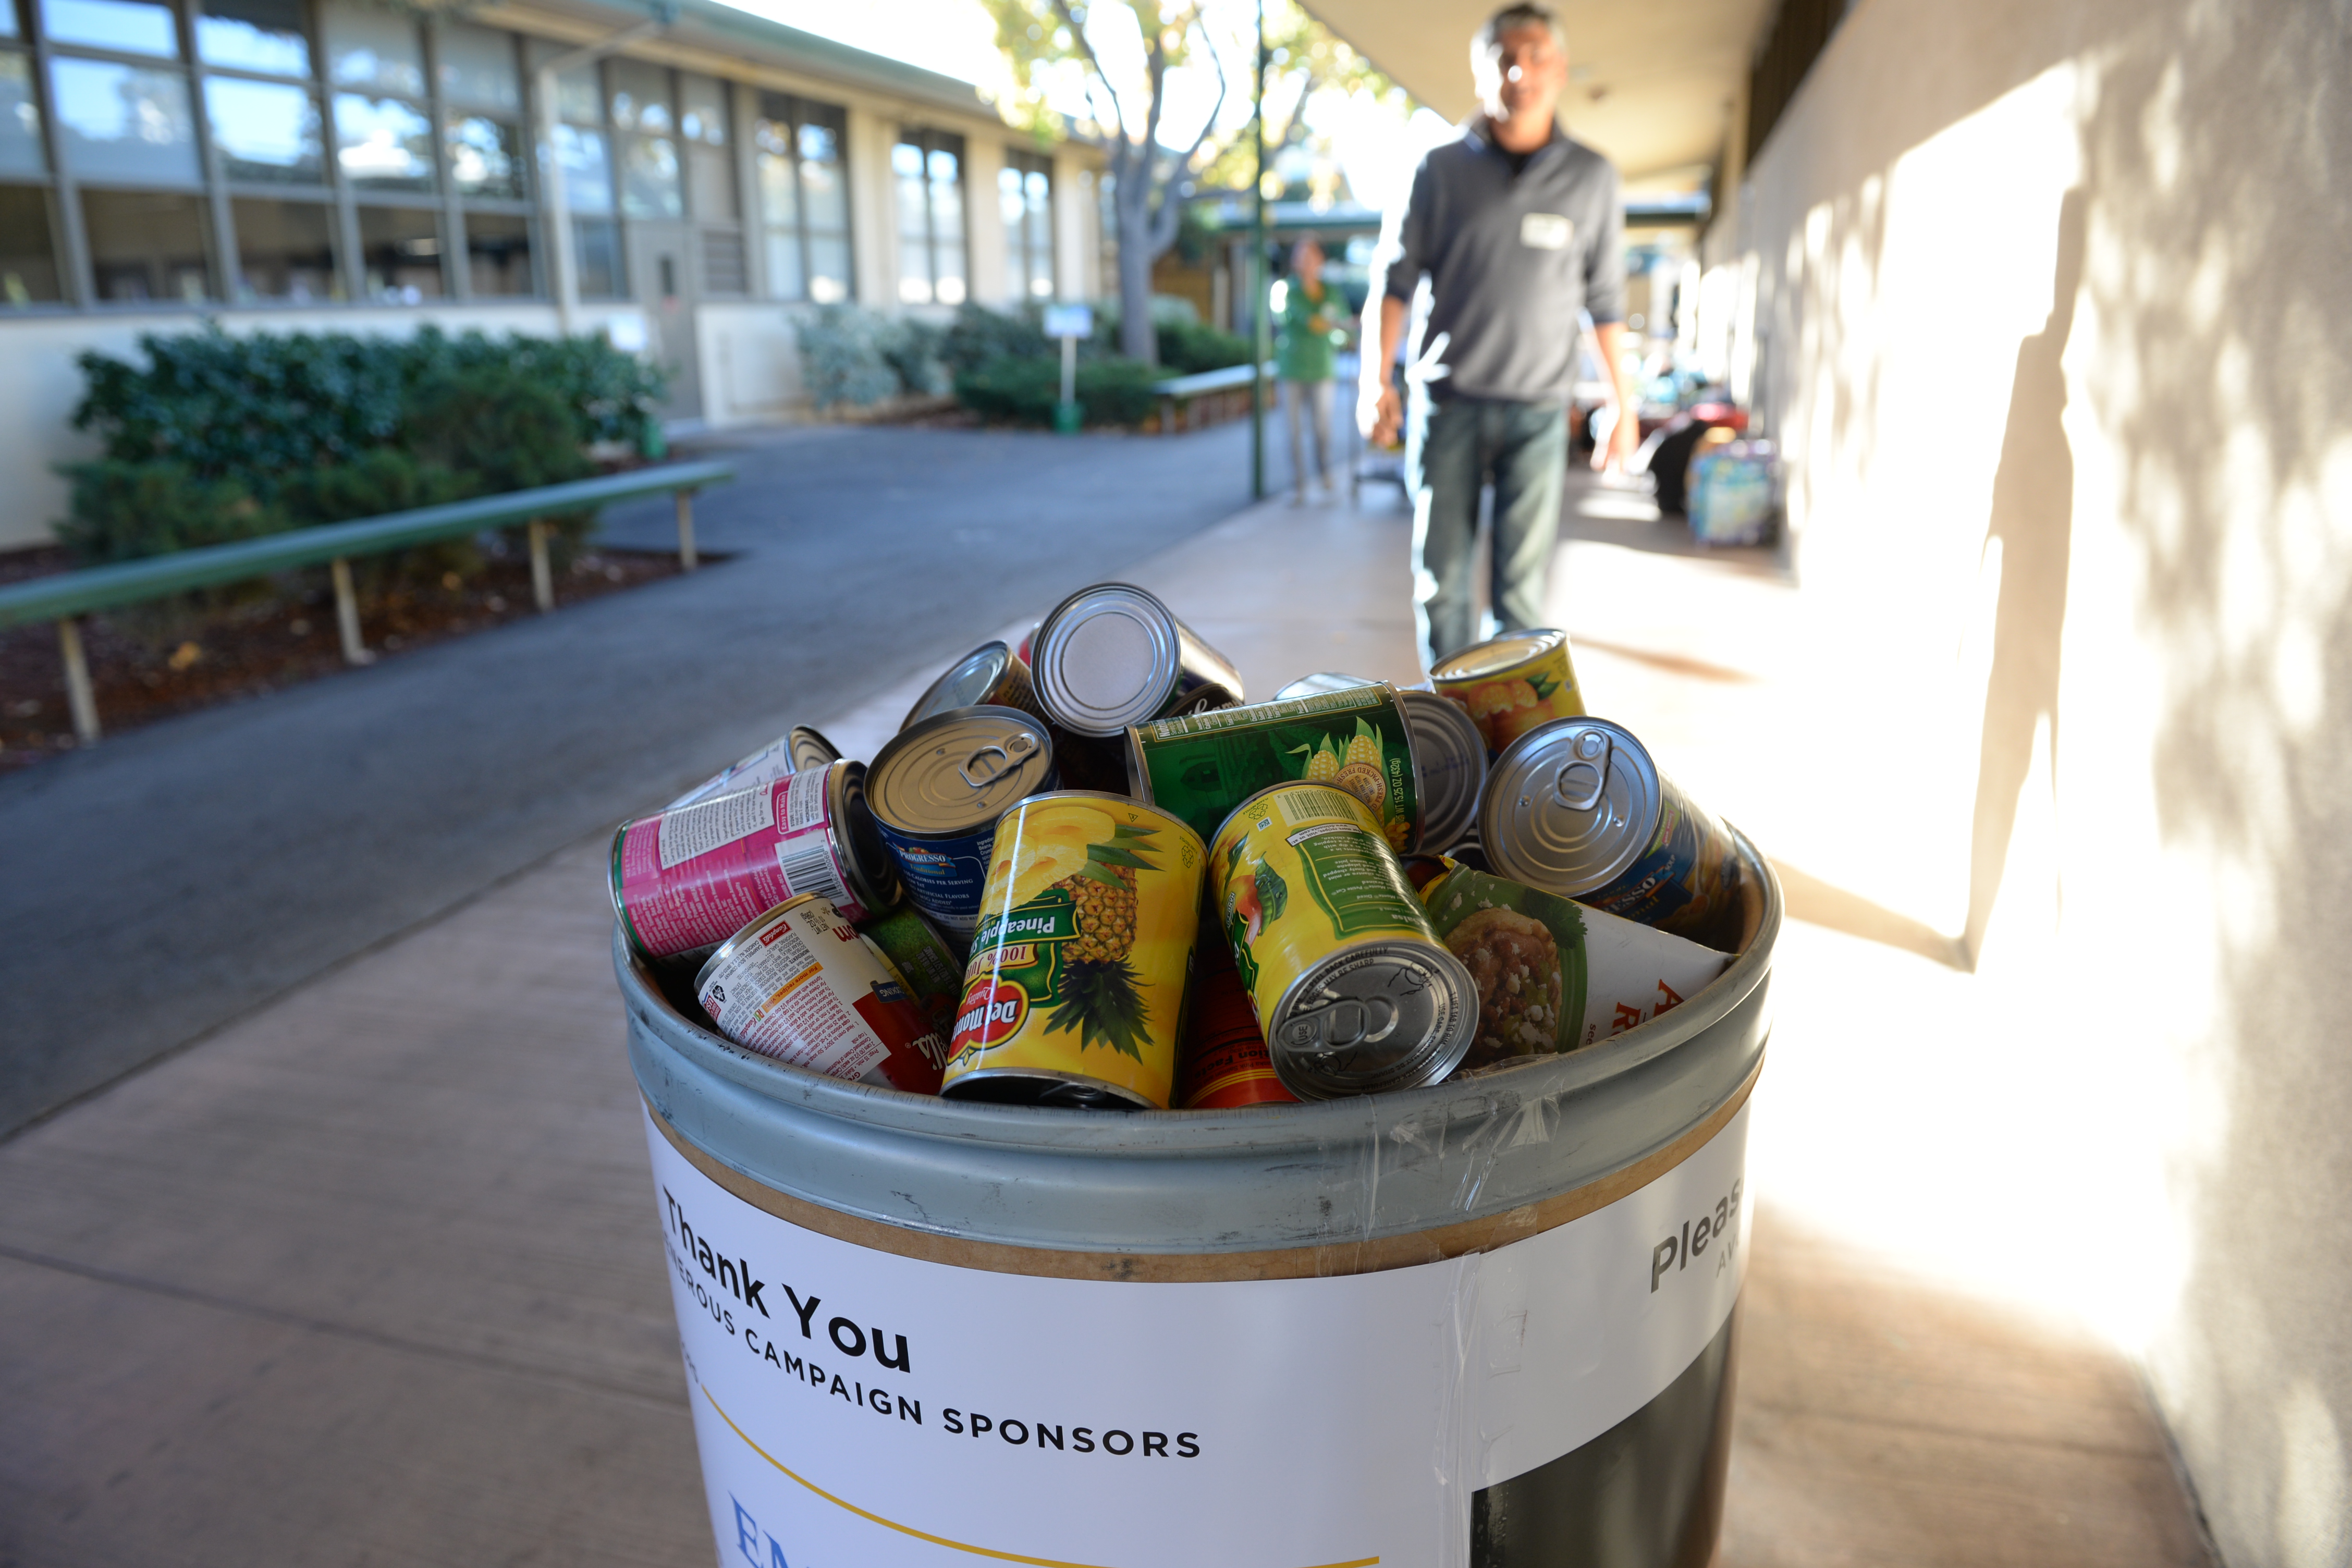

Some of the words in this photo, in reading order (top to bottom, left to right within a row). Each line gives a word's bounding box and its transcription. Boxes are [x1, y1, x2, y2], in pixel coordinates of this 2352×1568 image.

[1389, 758, 1403, 776] (432g)
[1337, 767, 1355, 782] FRESH
[1357, 767, 1379, 782] PACKED
[1392, 777, 1402, 787] OZ
[1256, 797, 1268, 806] PLEASE
[1392, 787, 1404, 803] 15.25
[1242, 804, 1256, 815] RECYCLE
[1395, 804, 1404, 813] WT
[1395, 814, 1404, 824] NET
[900, 850, 946, 862] PROGRESSO
[1664, 854, 1676, 871] SOUP
[910, 863, 945, 875] Traditional
[800, 908, 815, 922] (298g)
[818, 914, 825, 923] 10
[805, 918, 816, 929] OZ.
[820, 922, 829, 932] NET
[981, 915, 1055, 944] Pineapple
[761, 922, 788, 944] Campbell's
[811, 925, 822, 936] WT.
[742, 939, 759, 954] CAMDEN,
[777, 935, 800, 953] MONOSODIUM
[789, 943, 806, 958] SOYBEAN),
[744, 944, 763, 960] CAMPBELL
[787, 947, 810, 965] INGREDIENTS:
[987, 946, 1026, 966] 100%
[729, 956, 740, 966] U.S.A.
[736, 958, 746, 967] SOUP
[755, 953, 775, 971] GLUTAMATE,
[774, 955, 790, 969] MODIFIED
[777, 962, 789, 973] WATER,
[717, 963, 732, 978] 08103-1701
[723, 965, 738, 980] COMPANY
[765, 966, 775, 976] FOOD
[807, 965, 818, 974] For
[742, 971, 754, 982] YEAST
[752, 974, 766, 986] STARCH,
[756, 971, 778, 989] MUSHROOMS,
[794, 972, 808, 984] more
[807, 974, 823, 988] Sprinkle
[729, 982, 742, 995] EXTRACT,
[743, 985, 754, 996] WHEAT
[774, 981, 796, 999] recipes,
[735, 994, 745, 1004] FLOUR,
[743, 988, 760, 1003] VEGETABLE
[785, 990, 803, 1006] additional
[966, 986, 993, 1005] Quality
[764, 997, 777, 1009] visit:
[806, 1001, 819, 1014] lovers,
[813, 1002, 827, 1015] crunch,
[825, 998, 834, 1007] add
[762, 1011, 776, 1025] Cheddar
[827, 1012, 837, 1021] with
[840, 1018, 850, 1027] cups
[779, 1025, 791, 1037] bacon,
[811, 1017, 830, 1034] remaining
[830, 1024, 843, 1036] onions
[844, 1023, 855, 1033] Heat
[785, 1027, 798, 1040] toasted
[801, 1031, 814, 1043] onions.
[837, 1029, 847, 1038] oven
[1298, 1025, 1307, 1040] USE
[770, 1034, 782, 1047] cooked
[777, 1037, 788, 1047] sliced
[818, 1035, 829, 1045] 3-qt.
[852, 1035, 871, 1051] Condensed
[768, 1044, 780, 1057] almonds
[804, 1042, 821, 1057] casserole.
[843, 1048, 854, 1059] Cream
[807, 1052, 818, 1062] soup,
[824, 1059, 841, 1074] Mushroom
[1651, 1177, 1742, 1294] Pleas
[663, 1184, 770, 1319] Thank
[781, 1283, 911, 1373] You
[662, 1226, 735, 1336] ENEROUS
[745, 1328, 922, 1425] CAMPAIGN
[942, 1408, 1200, 1458] SPONSORS
